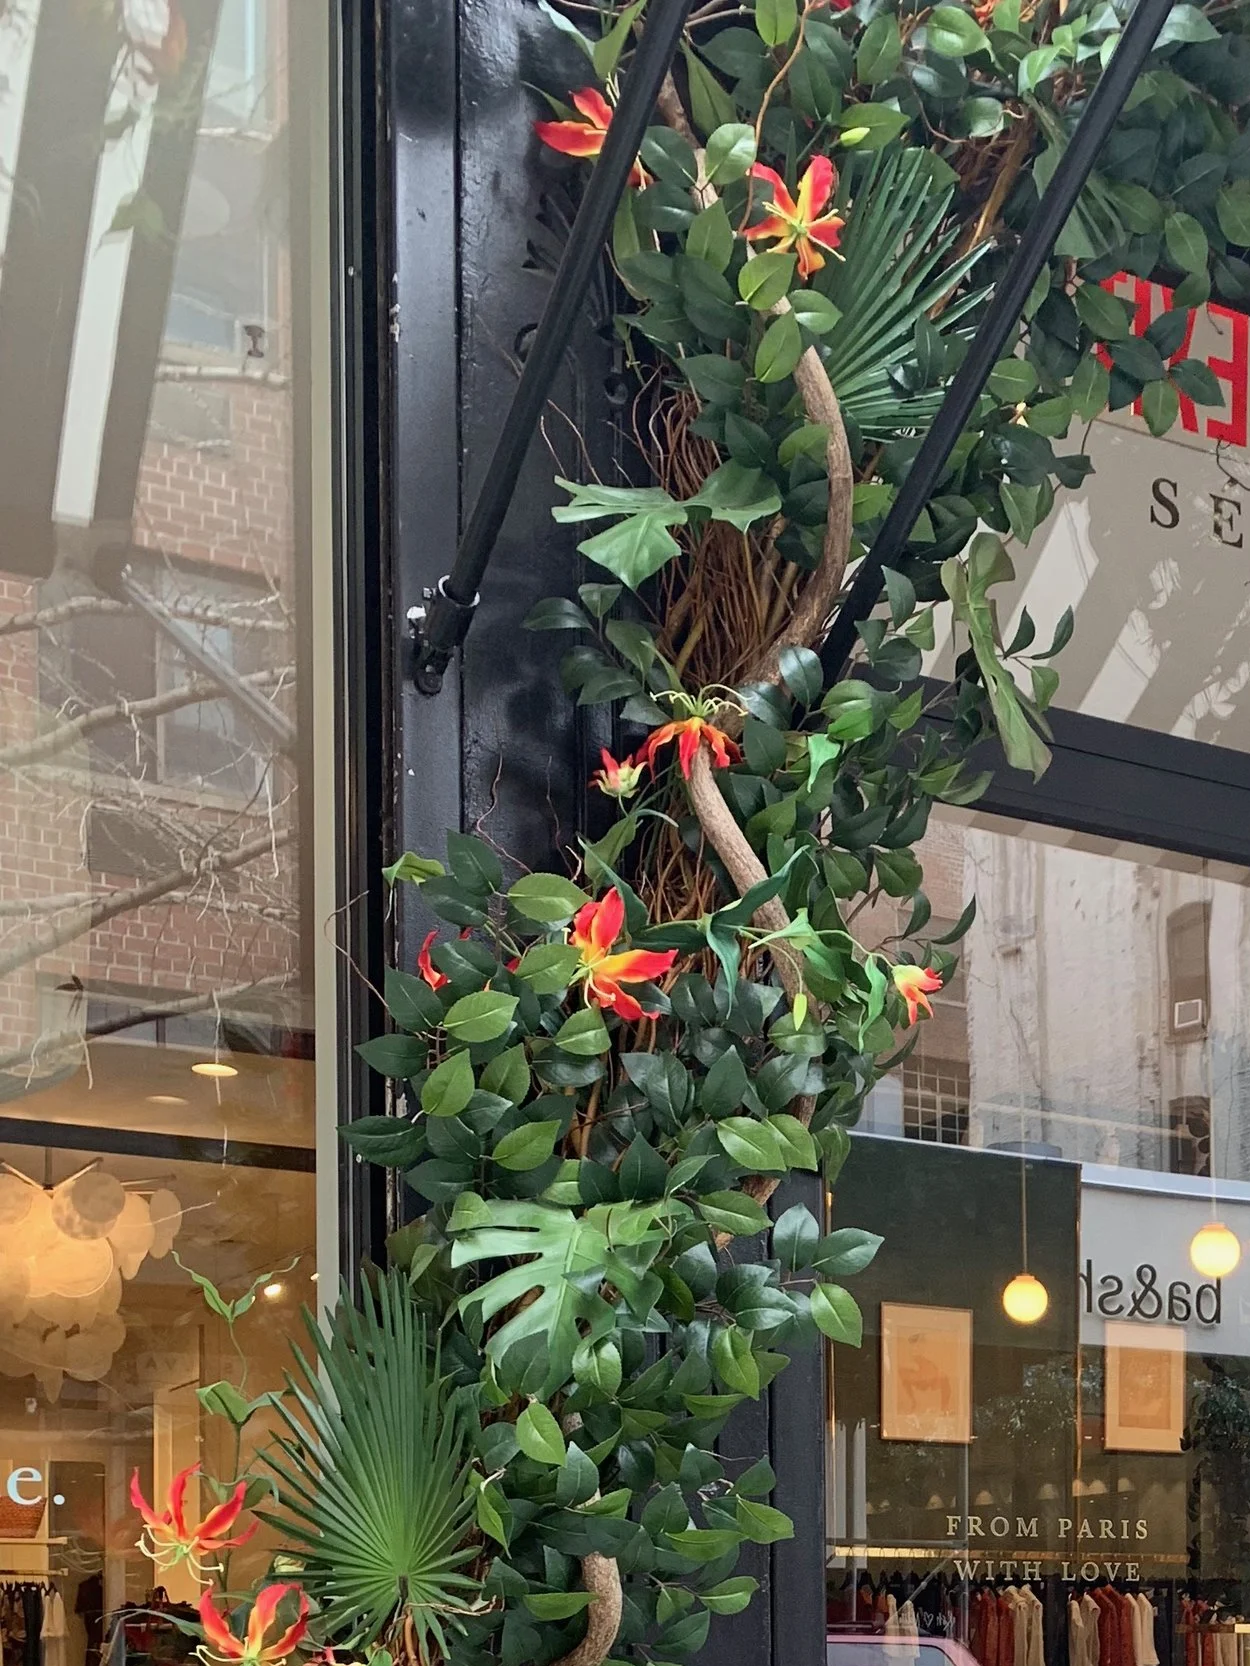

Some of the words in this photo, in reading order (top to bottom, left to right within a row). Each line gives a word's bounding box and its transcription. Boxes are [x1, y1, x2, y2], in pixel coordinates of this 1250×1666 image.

[946, 1515, 1039, 1538] FROM
[1058, 1518, 1149, 1540] PARIS
[953, 1559, 1042, 1581] WITH
[1061, 1561, 1141, 1582] LOVE
